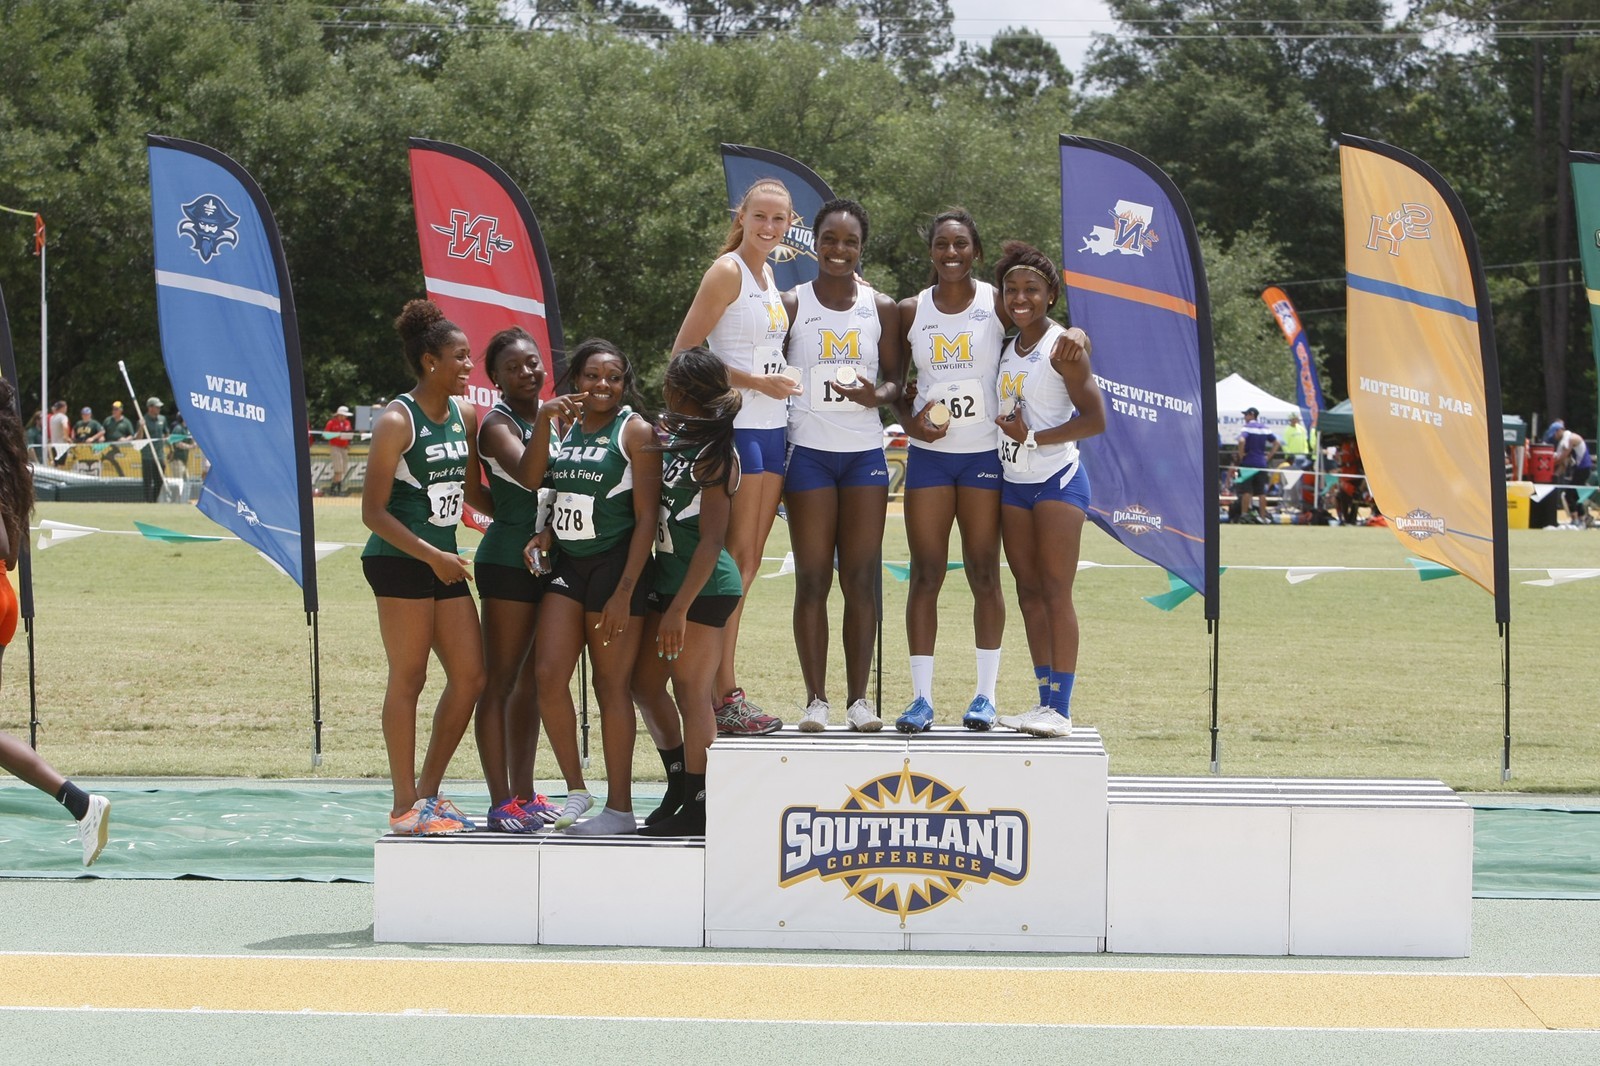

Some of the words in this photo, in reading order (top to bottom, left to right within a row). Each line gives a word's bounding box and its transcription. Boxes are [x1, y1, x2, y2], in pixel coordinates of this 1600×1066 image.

[762, 301, 789, 332] M
[818, 328, 862, 360] M
[929, 331, 974, 364] M
[931, 362, 974, 371] COWGIRLS
[999, 371, 1028, 402] M
[556, 446, 609, 464] SLU
[428, 469, 449, 481] Track
[577, 469, 604, 483] Field
[439, 493, 460, 519] 275
[556, 507, 584, 531] 278
[785, 812, 1023, 874] SOUTHLAND
[826, 850, 982, 872] CONFERENCE
